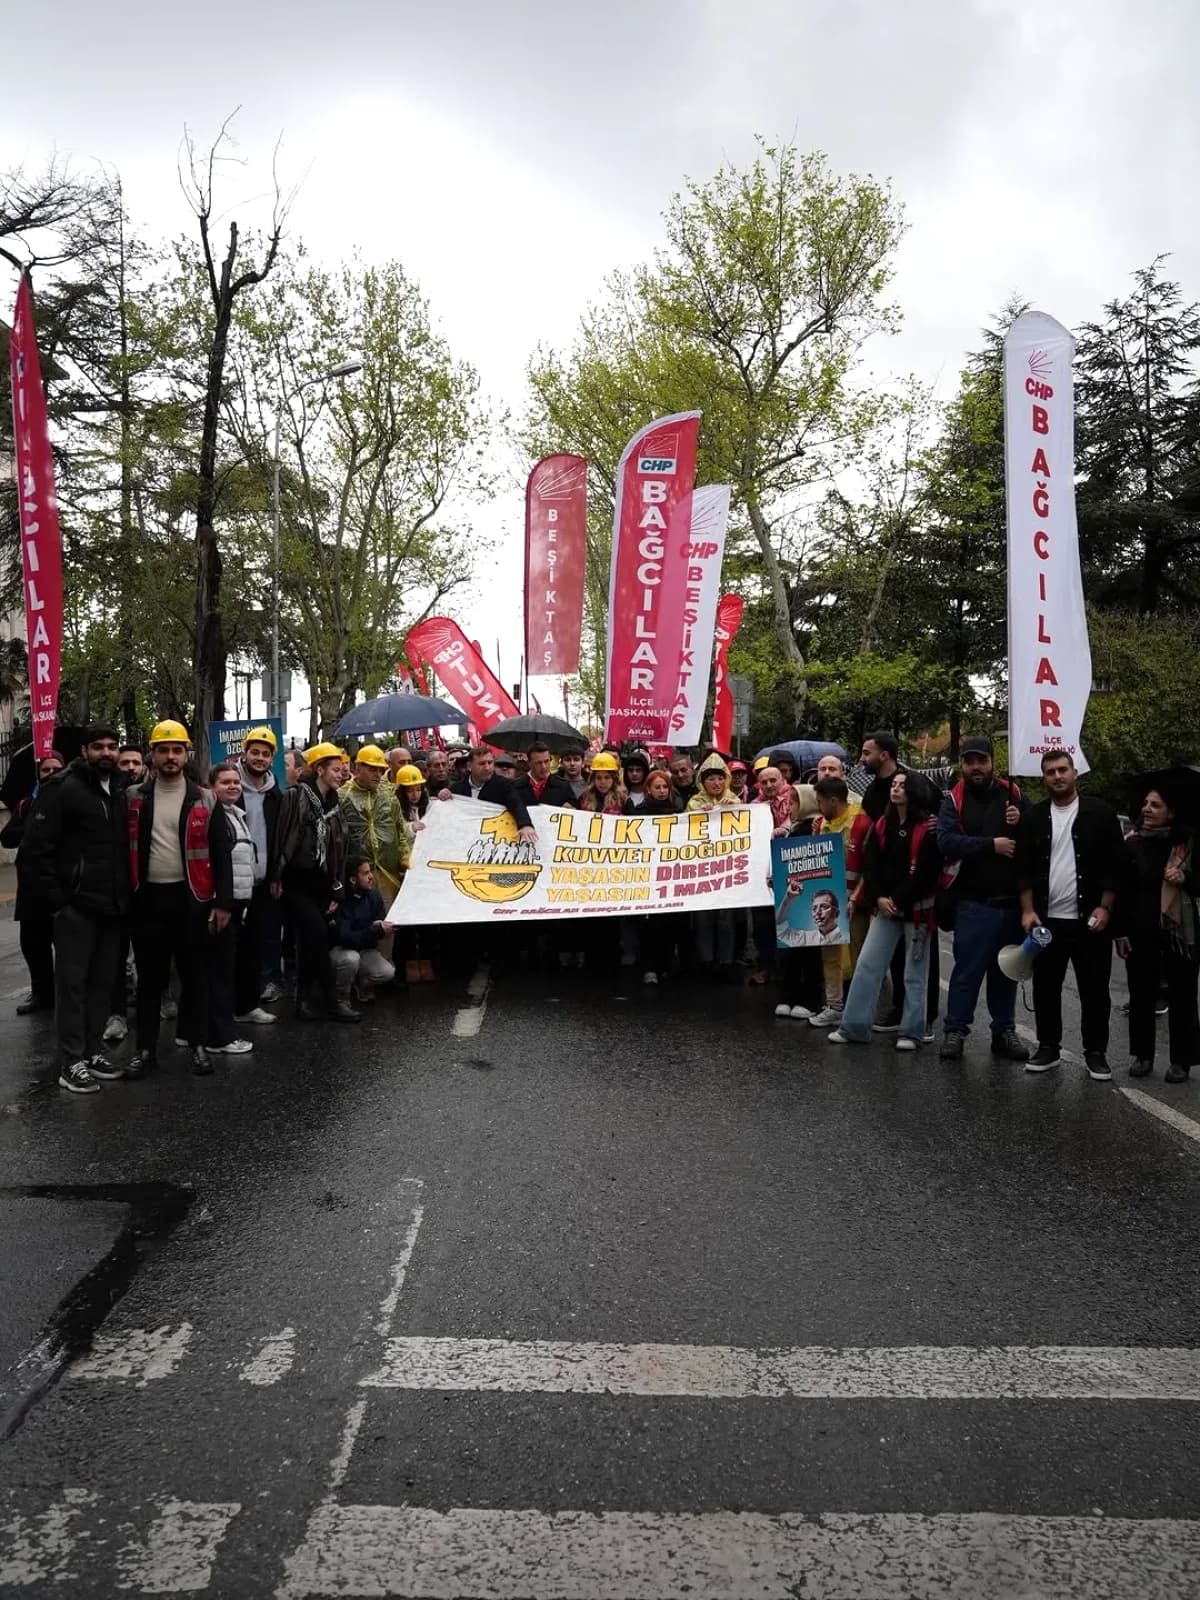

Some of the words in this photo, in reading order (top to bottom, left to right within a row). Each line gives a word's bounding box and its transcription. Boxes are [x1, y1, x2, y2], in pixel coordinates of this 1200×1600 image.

[1025, 377, 1054, 400] CHP
[641, 460, 673, 471] CHP
[680, 542, 718, 559] CHP
[1031, 404, 1062, 727] BAĞCILAR
[543, 509, 559, 667] BEŞİKTAŞ
[630, 480, 667, 690] BAĞCILAR
[671, 566, 703, 731] BEŞİKTAŞ
[630, 696, 654, 707] İLÇE
[1043, 733, 1062, 746] İLÇE
[553, 844, 654, 863] KUVVET
[660, 836, 751, 862] DOĞDU
[780, 840, 834, 861] İMAMOĞLU'NA
[550, 866, 651, 886] YAŞASIN
[655, 854, 749, 882] DİRENİŞ
[788, 855, 829, 874] ÖZGÜRLÜK!
[546, 887, 651, 903] YAŞASIN
[656, 885, 668, 899] 1
[673, 871, 749, 897] MAYIS
